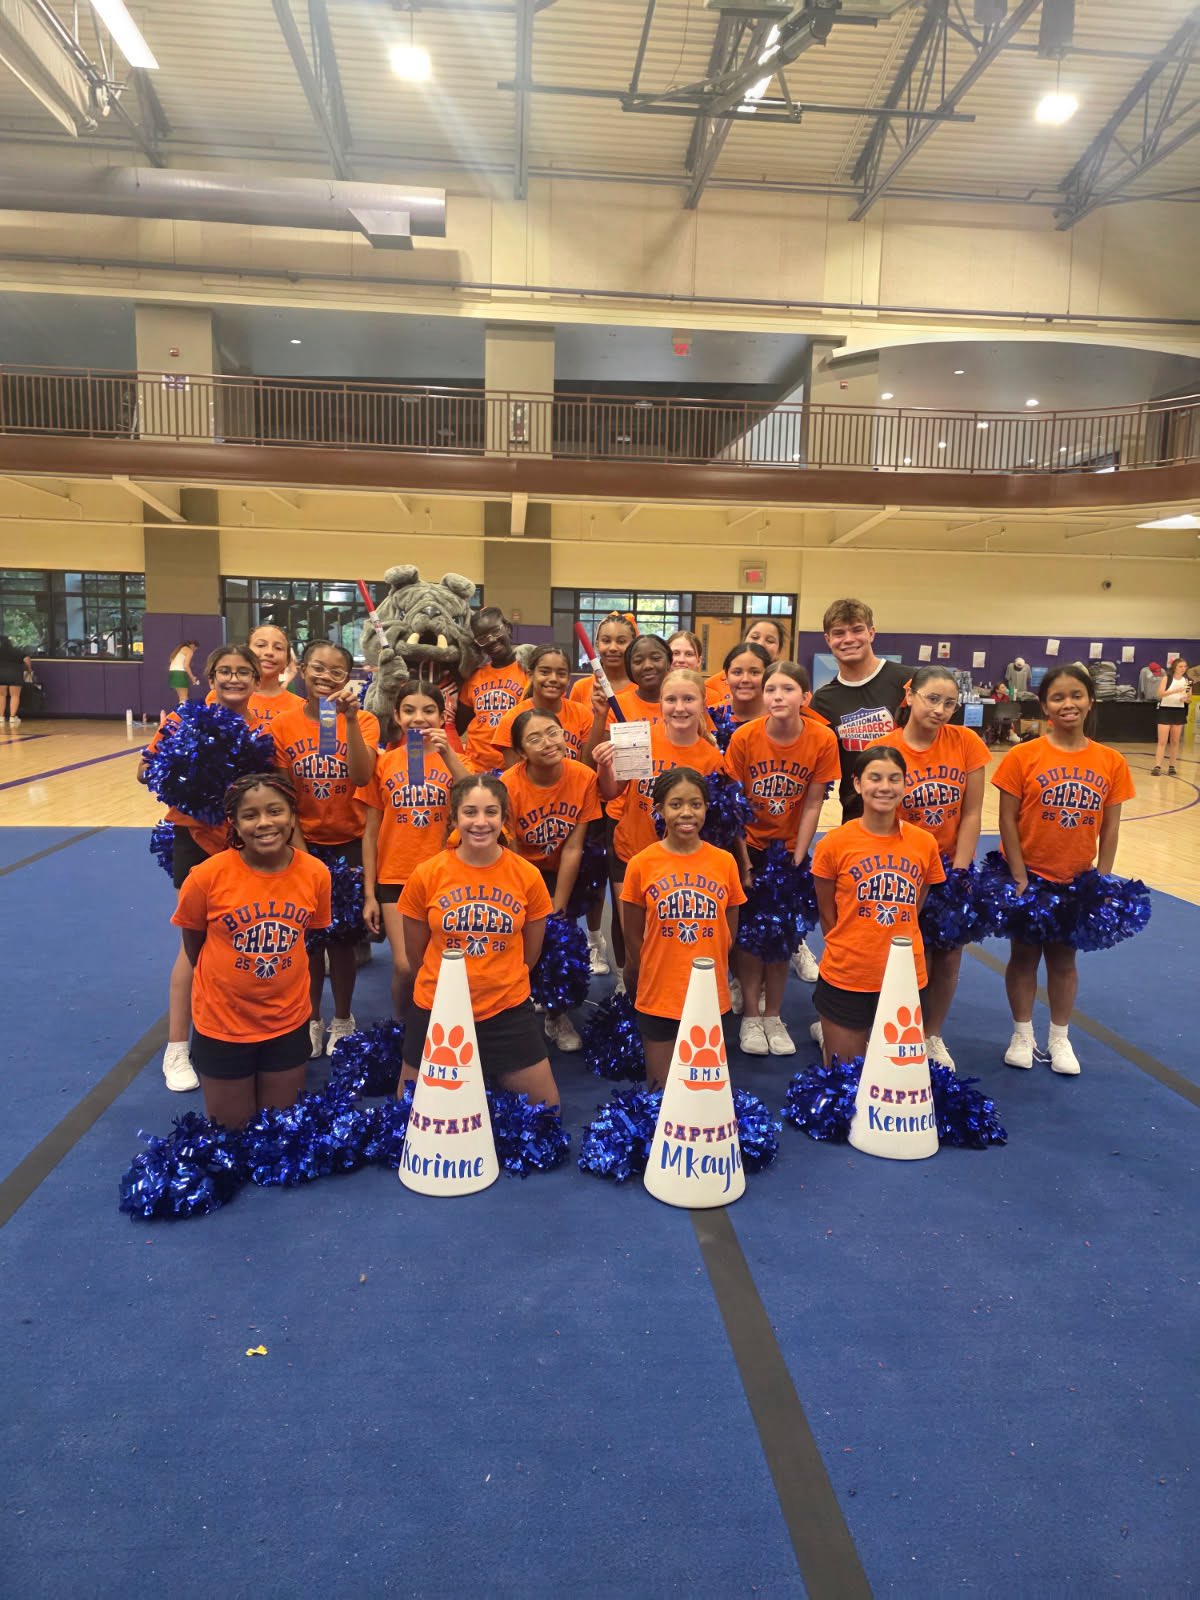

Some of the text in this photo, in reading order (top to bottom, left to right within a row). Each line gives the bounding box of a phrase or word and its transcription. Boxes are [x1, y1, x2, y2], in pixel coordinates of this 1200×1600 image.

[473, 679, 524, 697] BULLDOG
[476, 689, 517, 711] CHEER
[846, 714, 883, 728] NATIONAL
[293, 753, 349, 779] CHEER
[905, 765, 966, 787] ULLDOG
[385, 768, 453, 791] BUDOG
[751, 773, 805, 798] CHEER
[392, 782, 447, 808] CHEER
[901, 781, 961, 809] CHEER
[1041, 781, 1103, 811] CHEER
[396, 813, 408, 824] 25
[518, 802, 580, 830] BULLDO
[1041, 811, 1095, 826] 25 26
[649, 872, 725, 902] BULLDOG
[857, 871, 917, 906] CHEER
[438, 885, 523, 915] BULLDOG
[657, 889, 718, 920] CHEER
[858, 906, 872, 918] 25
[442, 902, 514, 934] CHEER
[661, 926, 714, 938] 25 26
[446, 938, 506, 952] 25 26
[235, 956, 292, 971] 25 26
[402, 1138, 485, 1179] Korinne
